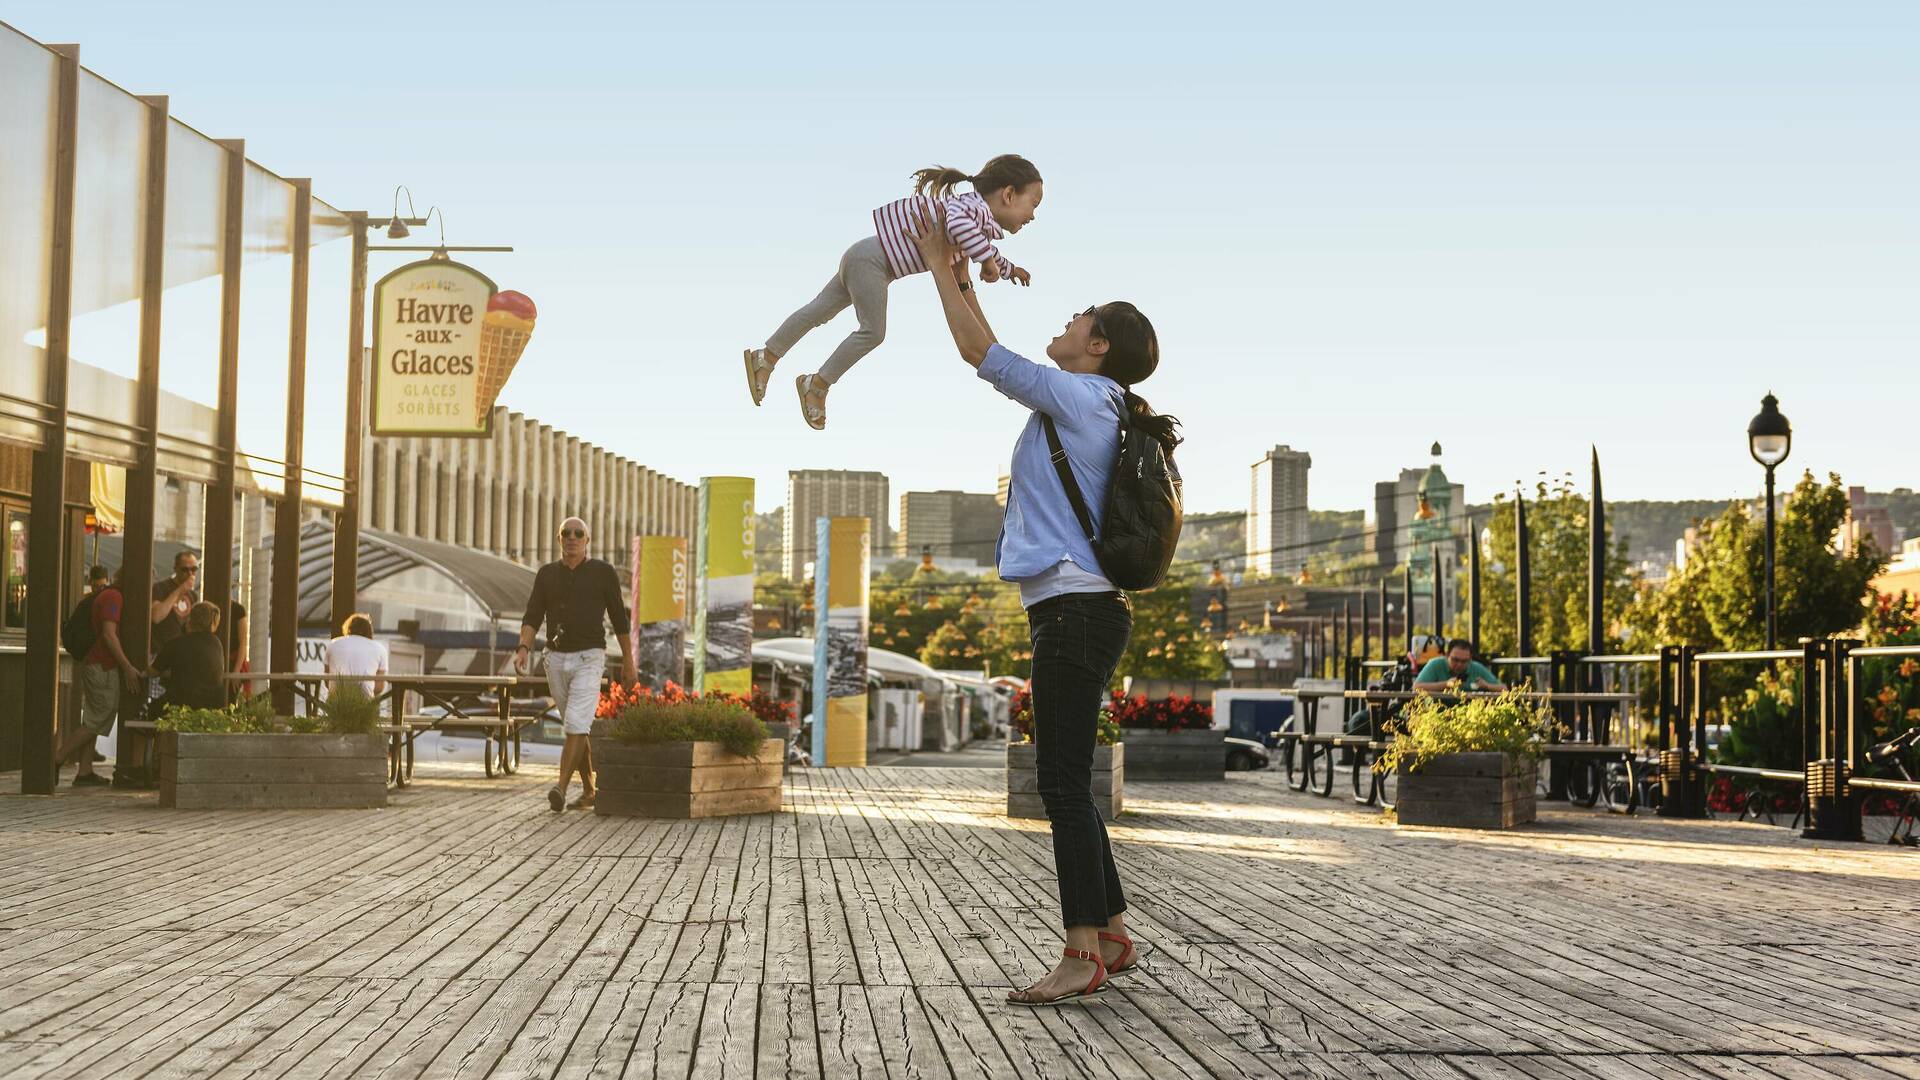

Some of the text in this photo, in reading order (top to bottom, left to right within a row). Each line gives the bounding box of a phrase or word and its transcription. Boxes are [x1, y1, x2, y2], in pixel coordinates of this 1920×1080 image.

[396, 298, 474, 324] Havre
[391, 349, 474, 375] Glaces
[403, 384, 457, 397] GLACES
[397, 402, 461, 416] SORBETS
[672, 548, 687, 604] 1897
